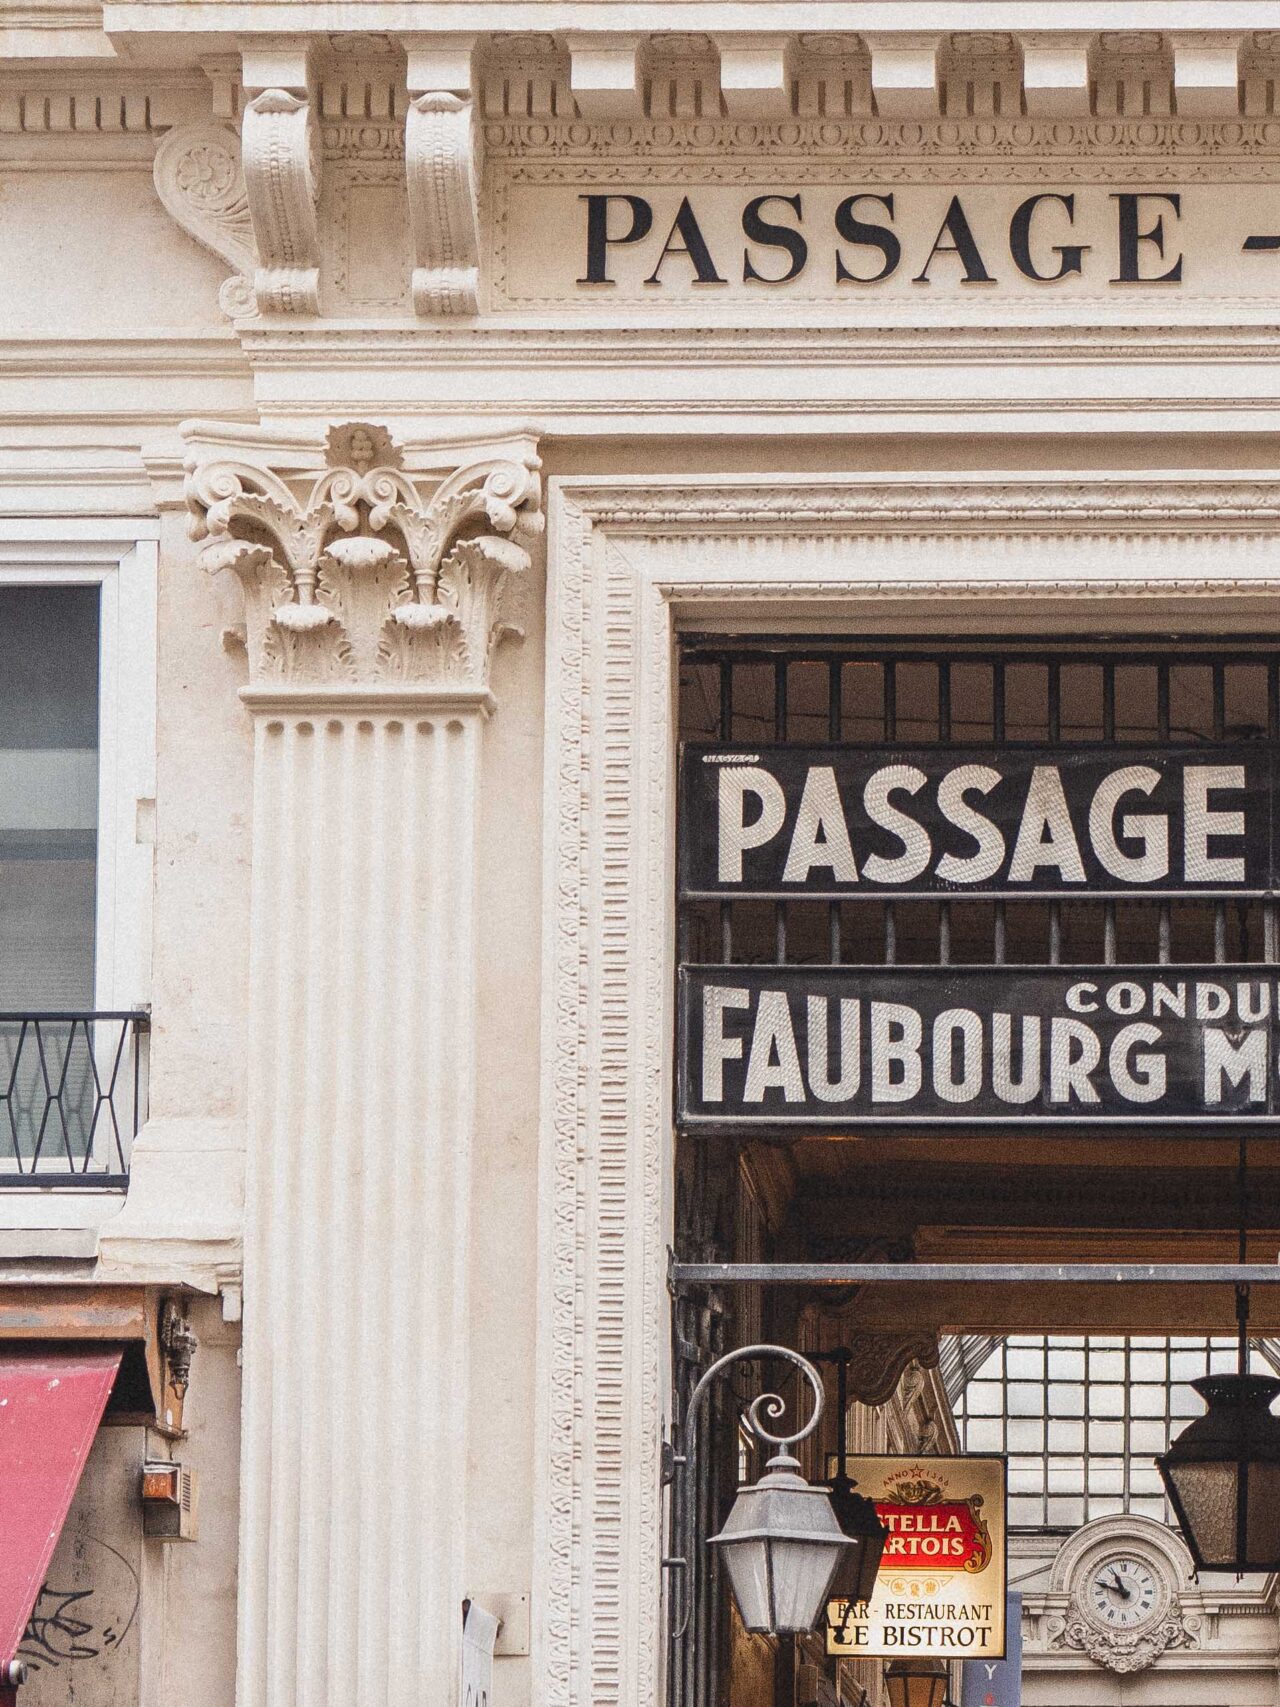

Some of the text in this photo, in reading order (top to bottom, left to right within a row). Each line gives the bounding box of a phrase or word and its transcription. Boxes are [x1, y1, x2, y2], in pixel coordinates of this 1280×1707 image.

[576, 193, 1183, 285] PASSAGE
[717, 764, 1246, 883] PASSAGE
[702, 985, 1167, 1104] FAUBOURG
[882, 1470, 908, 1488] ANNO
[883, 1625, 992, 1647] BISTROT
[885, 1603, 992, 1621] RESTAURANT
